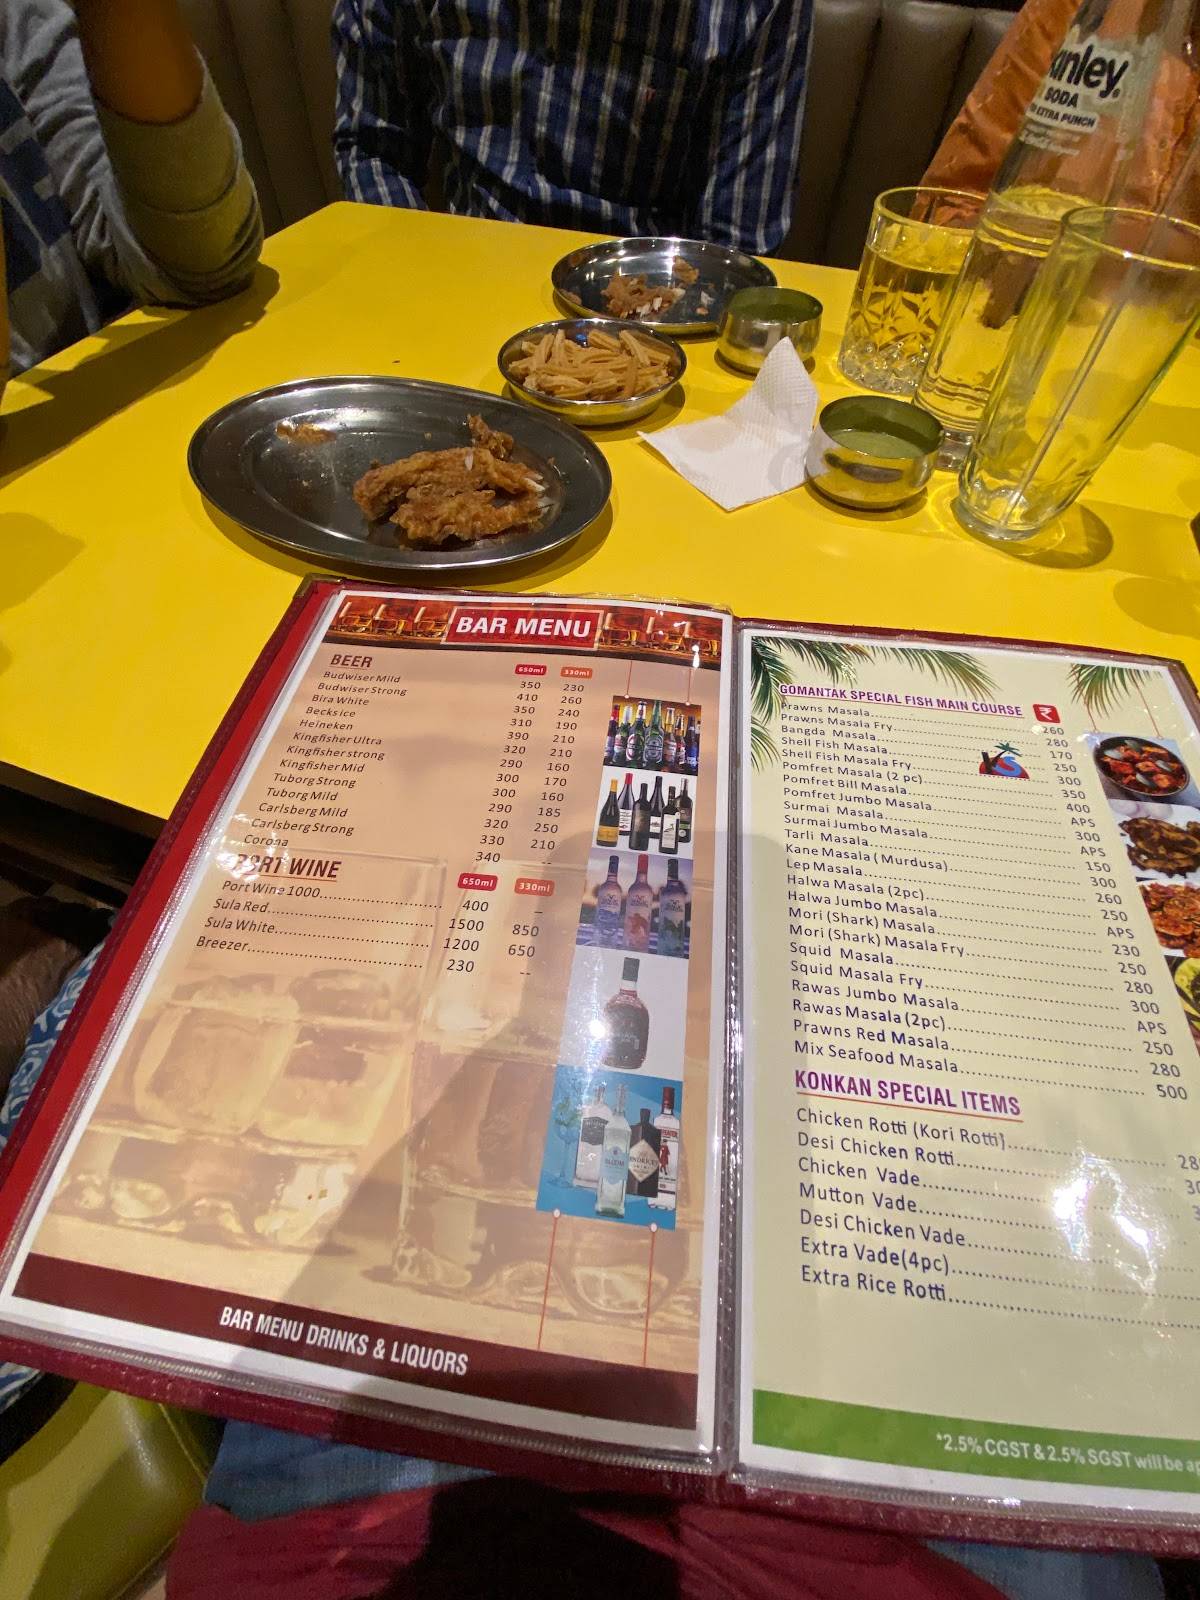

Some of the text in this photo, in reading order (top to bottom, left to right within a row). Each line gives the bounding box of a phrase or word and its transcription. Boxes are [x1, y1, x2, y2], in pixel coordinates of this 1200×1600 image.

[1044, 87, 1079, 108] SODA
[1061, 113, 1096, 128] PUNCH
[456, 617, 591, 637] BAR MENU
[330, 654, 373, 668] BEER
[318, 683, 408, 696] Budwiser Strong
[324, 671, 375, 682] Budwiser
[376, 675, 401, 683] Mild
[306, 707, 356, 717] Becks ice
[312, 694, 535, 714] Bira White 350
[780, 685, 1023, 715] GOMANTAK SPECIAL FISH MAIN COURSE
[781, 703, 870, 717] Prawns Masala
[293, 732, 382, 745] Kingfisher Ultra
[300, 719, 529, 740] Heineken 390
[781, 726, 1072, 760] Bangda Masala 170
[280, 759, 365, 772] Kingfisher Mid
[287, 746, 522, 768] Kingfisher strong 290
[782, 737, 1077, 773] Shell Fish Masala 250
[274, 773, 516, 797] Tuborg Strong 300
[783, 762, 833, 773] Pomfret
[838, 767, 882, 779] Masala
[267, 788, 338, 801] Tuborg Mild
[783, 775, 1090, 813] Pomfret Bill Masala 400
[783, 788, 1096, 828] Pomfret Jumbo Masala APS
[252, 818, 354, 836] Carlsberg Strong
[259, 802, 508, 829] Carlsberg Mild 320
[784, 815, 928, 838] Surmai Jumbo Masala
[244, 835, 500, 862] Corona 340
[785, 829, 1111, 872] Tarli Masala 150
[289, 858, 341, 878] WINE
[462, 877, 493, 887] 650ml
[519, 882, 550, 892] 330ml
[786, 844, 819, 856] Kane
[822, 848, 870, 862] Masala
[1090, 877, 1116, 889] 300
[787, 859, 863, 876] Lep Masala
[222, 881, 489, 912] Port Wine 1000 400
[213, 899, 540, 937] Sula Red 1500 850
[788, 891, 1135, 939] Halwa Jumbo Masala APS
[205, 917, 535, 958] Sula White 1200 650
[789, 907, 1140, 957] Mori (Shark) Masala 230
[196, 936, 475, 972] Breezer 230
[791, 960, 923, 989] Squid Masala Fry
[792, 980, 1167, 1035] Rawas Jumbo Masala APS
[793, 999, 1174, 1056] Rawas Masala (2pc) 250
[794, 1019, 949, 1051] Prawns Red Masala
[795, 1040, 1188, 1100] Mix Seafood Masala 500
[795, 1070, 1021, 1115] KONKAN SPECIAL ITEMS
[797, 1108, 1200, 1171] Chicken Rotti (Kori Rotti) 28
[799, 1131, 955, 1166] Desi Chicken Rotti
[799, 1157, 920, 1187] Chicken Vade
[799, 1182, 917, 1213] Mutton Vade
[800, 1209, 966, 1246] Desi Chicken Vade
[801, 1237, 848, 1258] Extra
[802, 1265, 946, 1301] Extra Rice Rotti
[219, 1306, 469, 1376] BAR MENU DRINKS & LIQUORS
[985, 1439, 1029, 1459] CGST
[1033, 1444, 1045, 1460] &
[1047, 1446, 1085, 1464] 2.5%
[1088, 1449, 1131, 1467] SGST
[1134, 1455, 1162, 1470] will
[1164, 1456, 1183, 1472] be
